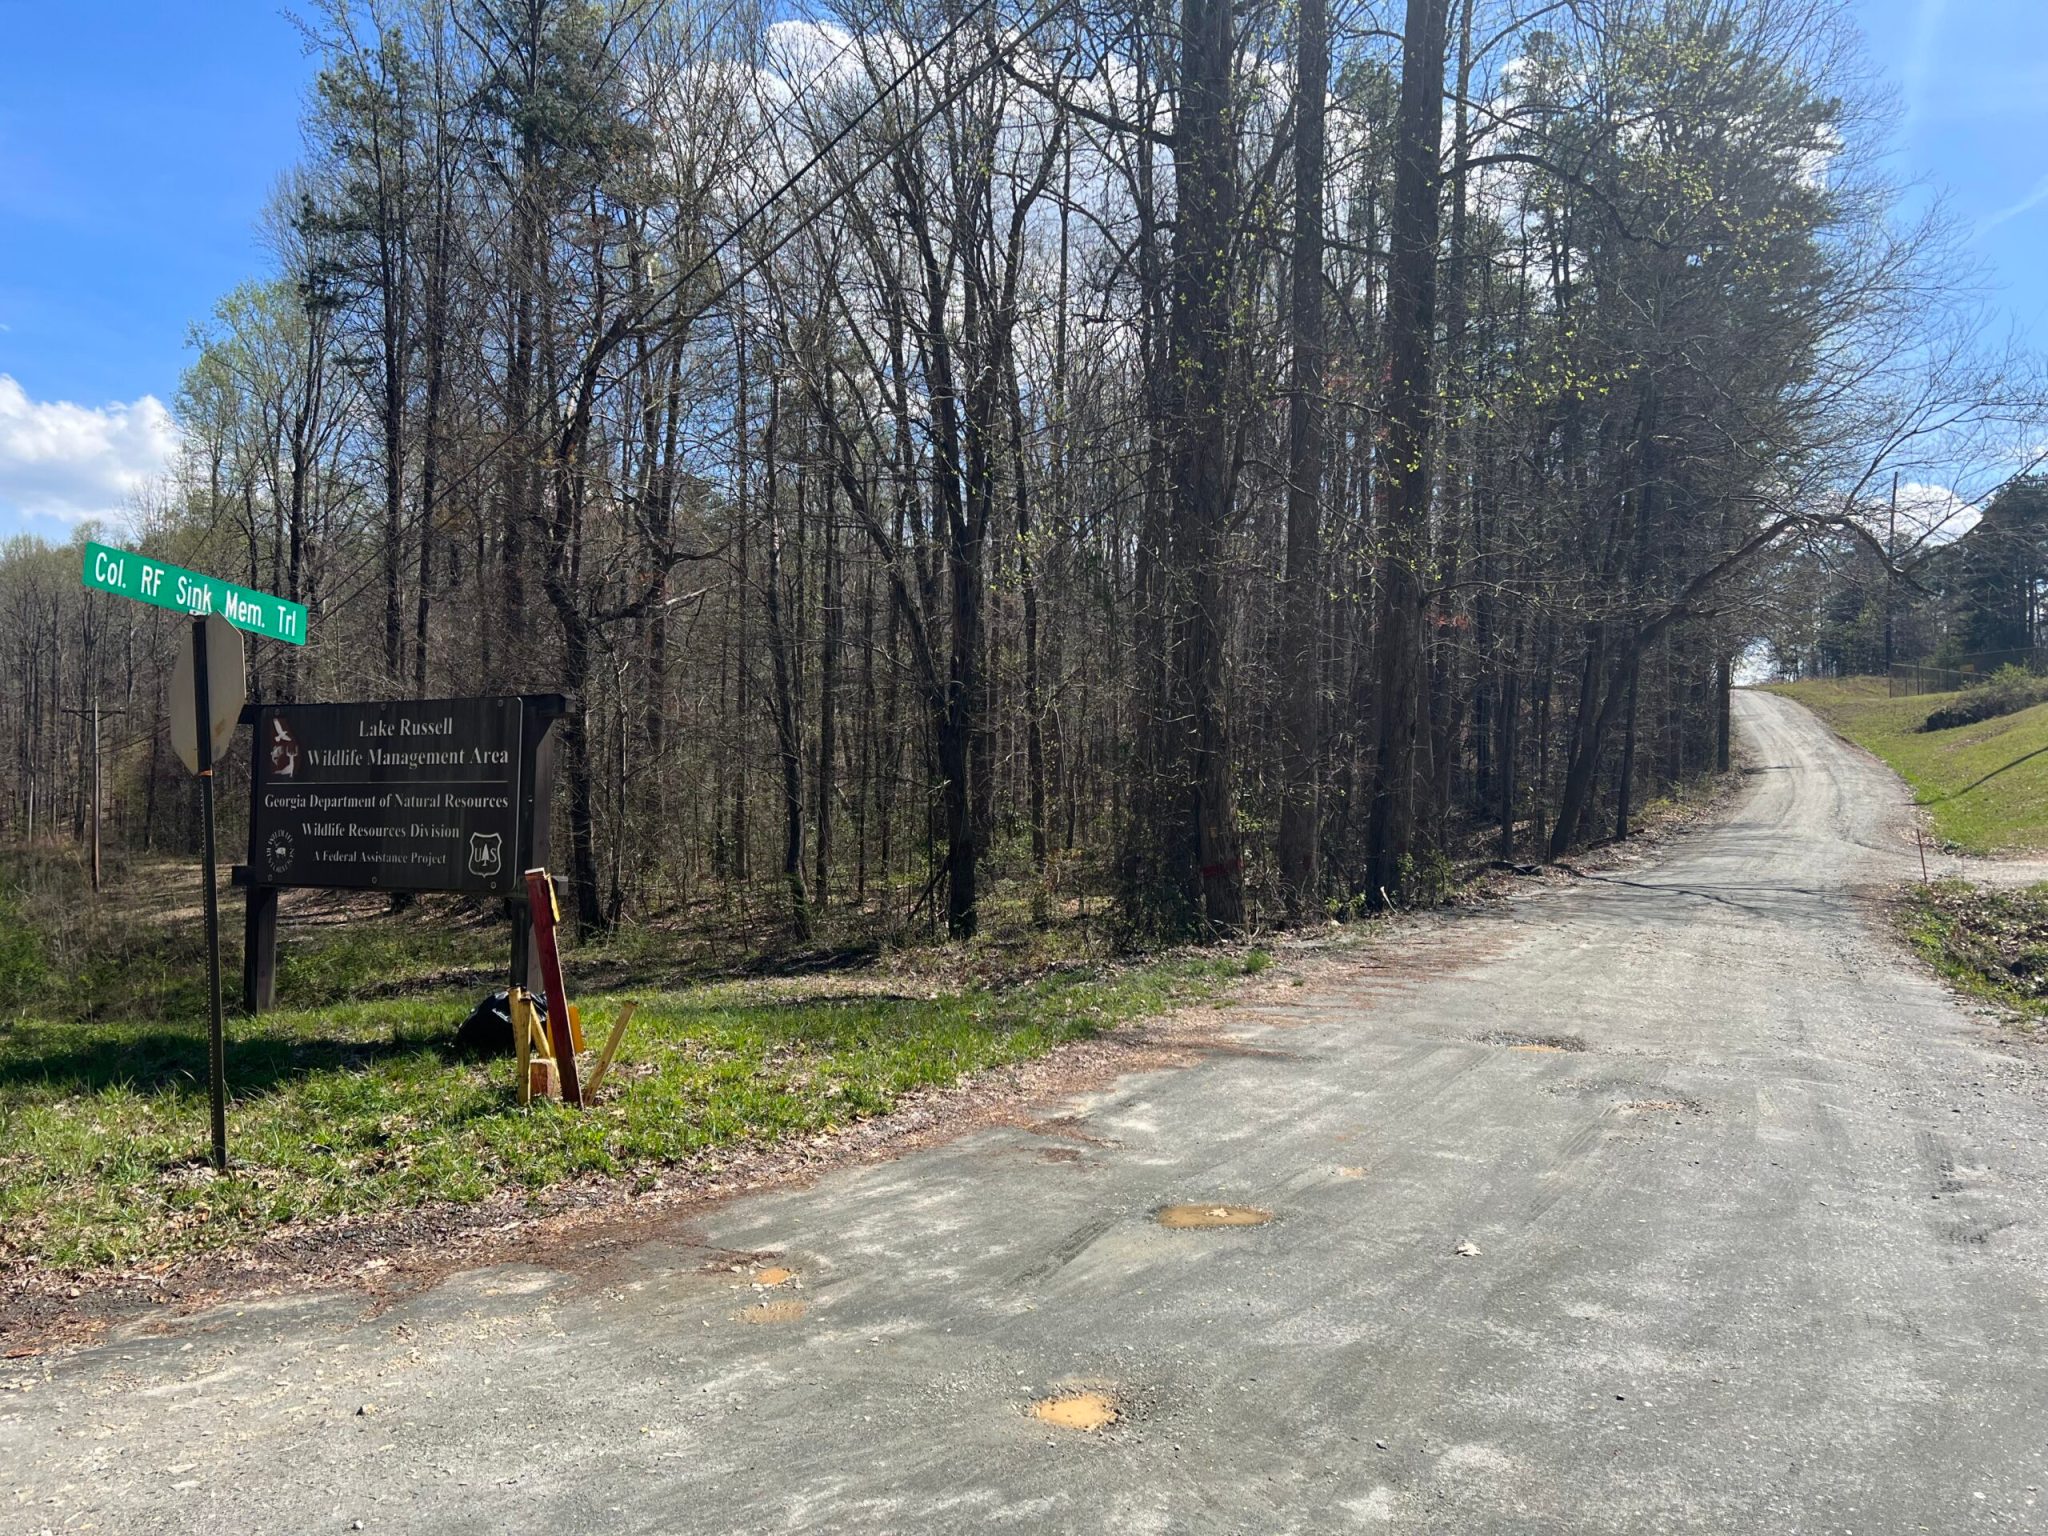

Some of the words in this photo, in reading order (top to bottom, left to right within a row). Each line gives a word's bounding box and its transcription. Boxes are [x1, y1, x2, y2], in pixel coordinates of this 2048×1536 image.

[95, 552, 127, 589] Col.
[141, 565, 165, 597] RF
[176, 576, 212, 613] Sink
[225, 590, 265, 628] Mem.
[277, 605, 296, 637] Trl
[359, 719, 395, 737] Lake
[400, 717, 453, 736] Russell
[307, 749, 363, 767] Wildlife
[367, 748, 465, 770] Management
[469, 747, 509, 764] Area
[264, 793, 306, 811] Georgia
[309, 794, 376, 812] Department
[379, 793, 393, 808] of
[394, 793, 441, 808] Natural
[444, 793, 509, 808] Resources
[302, 822, 346, 837] Wildlife
[348, 823, 406, 837] Resources
[410, 823, 460, 838] Division
[313, 850, 320, 861] A
[322, 850, 357, 862] Federal
[360, 851, 408, 864] Assistance
[411, 851, 446, 867] Project
